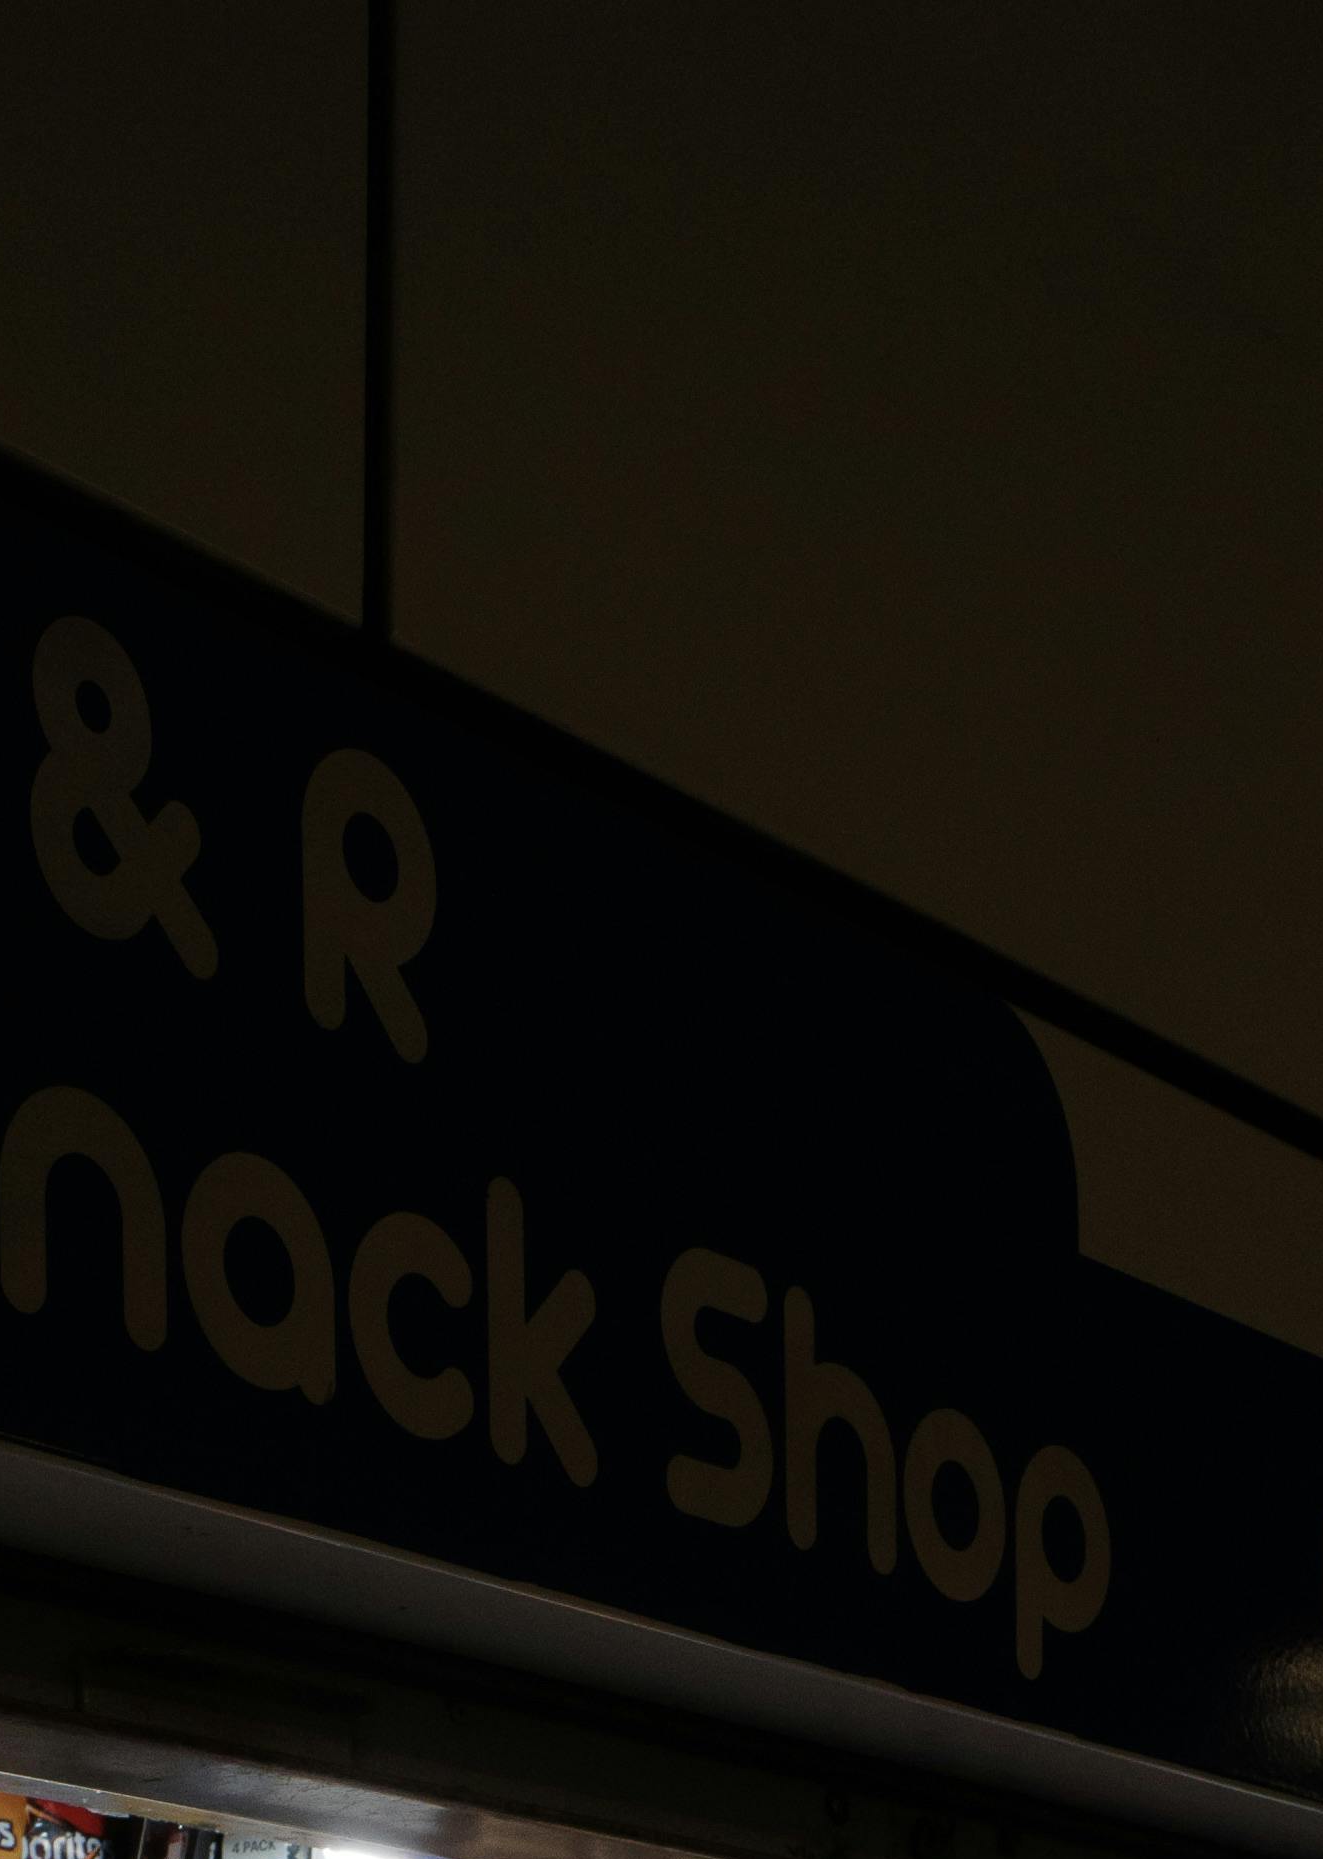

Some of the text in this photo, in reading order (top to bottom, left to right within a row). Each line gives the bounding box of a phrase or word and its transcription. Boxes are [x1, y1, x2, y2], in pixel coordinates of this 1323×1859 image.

[28, 614, 220, 981] &
[301, 746, 438, 1064] R
[660, 1246, 1114, 1682] Shop
